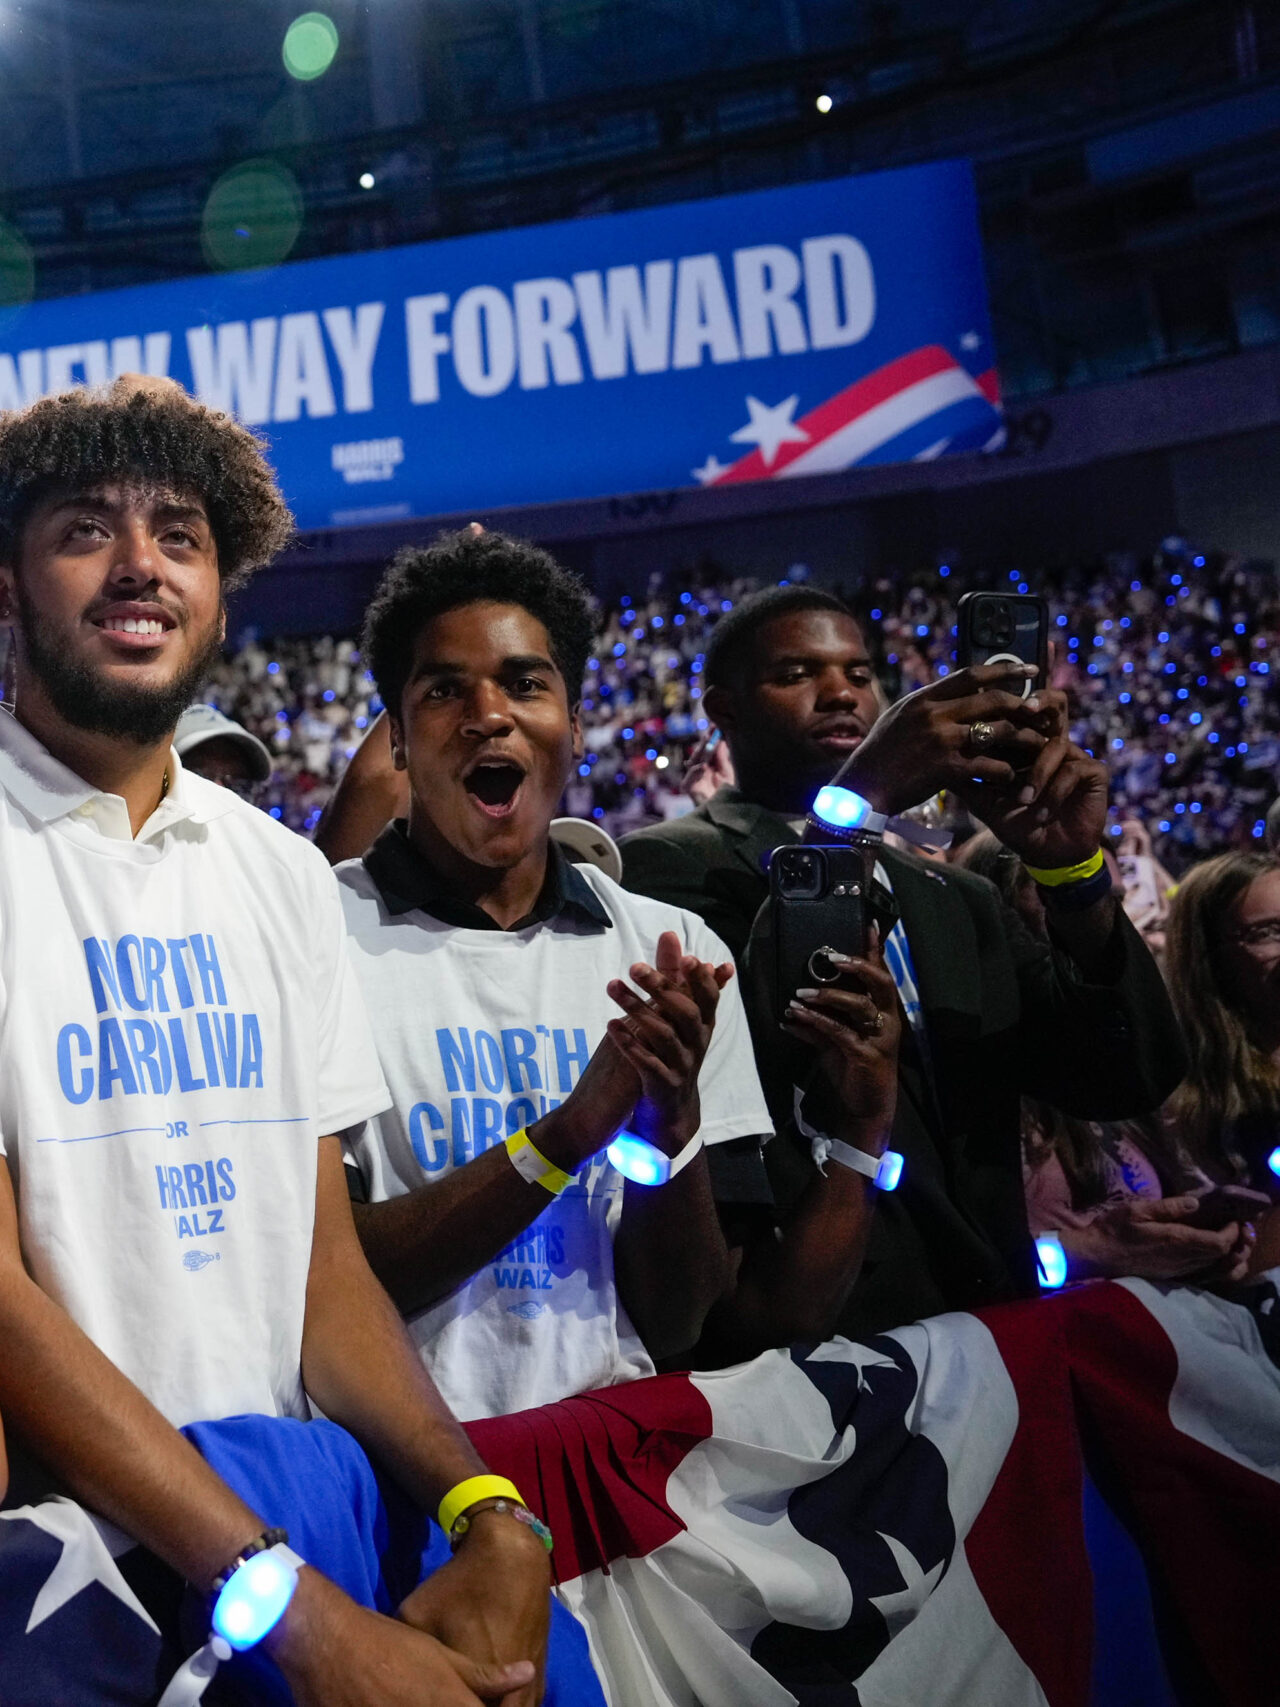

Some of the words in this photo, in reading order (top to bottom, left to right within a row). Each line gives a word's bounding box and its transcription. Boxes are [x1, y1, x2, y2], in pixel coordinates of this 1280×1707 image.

[185, 302, 385, 425] WAY
[405, 233, 876, 405] FORWARD
[83, 933, 228, 1014] NORTH
[165, 1120, 190, 1138] OR
[409, 1095, 561, 1172] CARO
[155, 1157, 236, 1209] HRRIS
[174, 1208, 225, 1239] ALZ
[496, 1225, 565, 1264] RRIS
